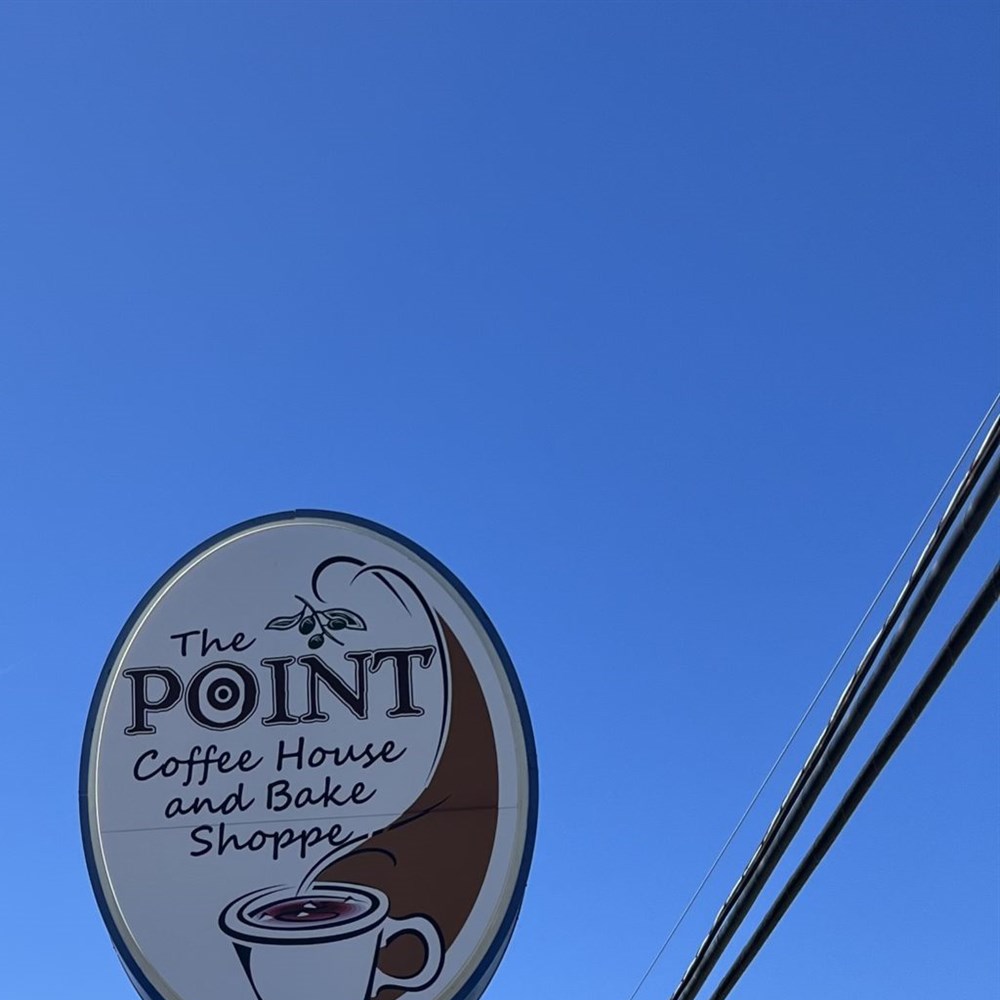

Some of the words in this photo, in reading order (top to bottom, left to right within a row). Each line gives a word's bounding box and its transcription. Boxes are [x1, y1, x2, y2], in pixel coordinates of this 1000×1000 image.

[170, 628, 256, 658] The
[123, 645, 437, 736] POINT
[133, 744, 263, 787] Coffee
[276, 736, 407, 771] House
[164, 784, 255, 818] and
[265, 776, 377, 812] Bake
[189, 823, 355, 860] Shoppe
